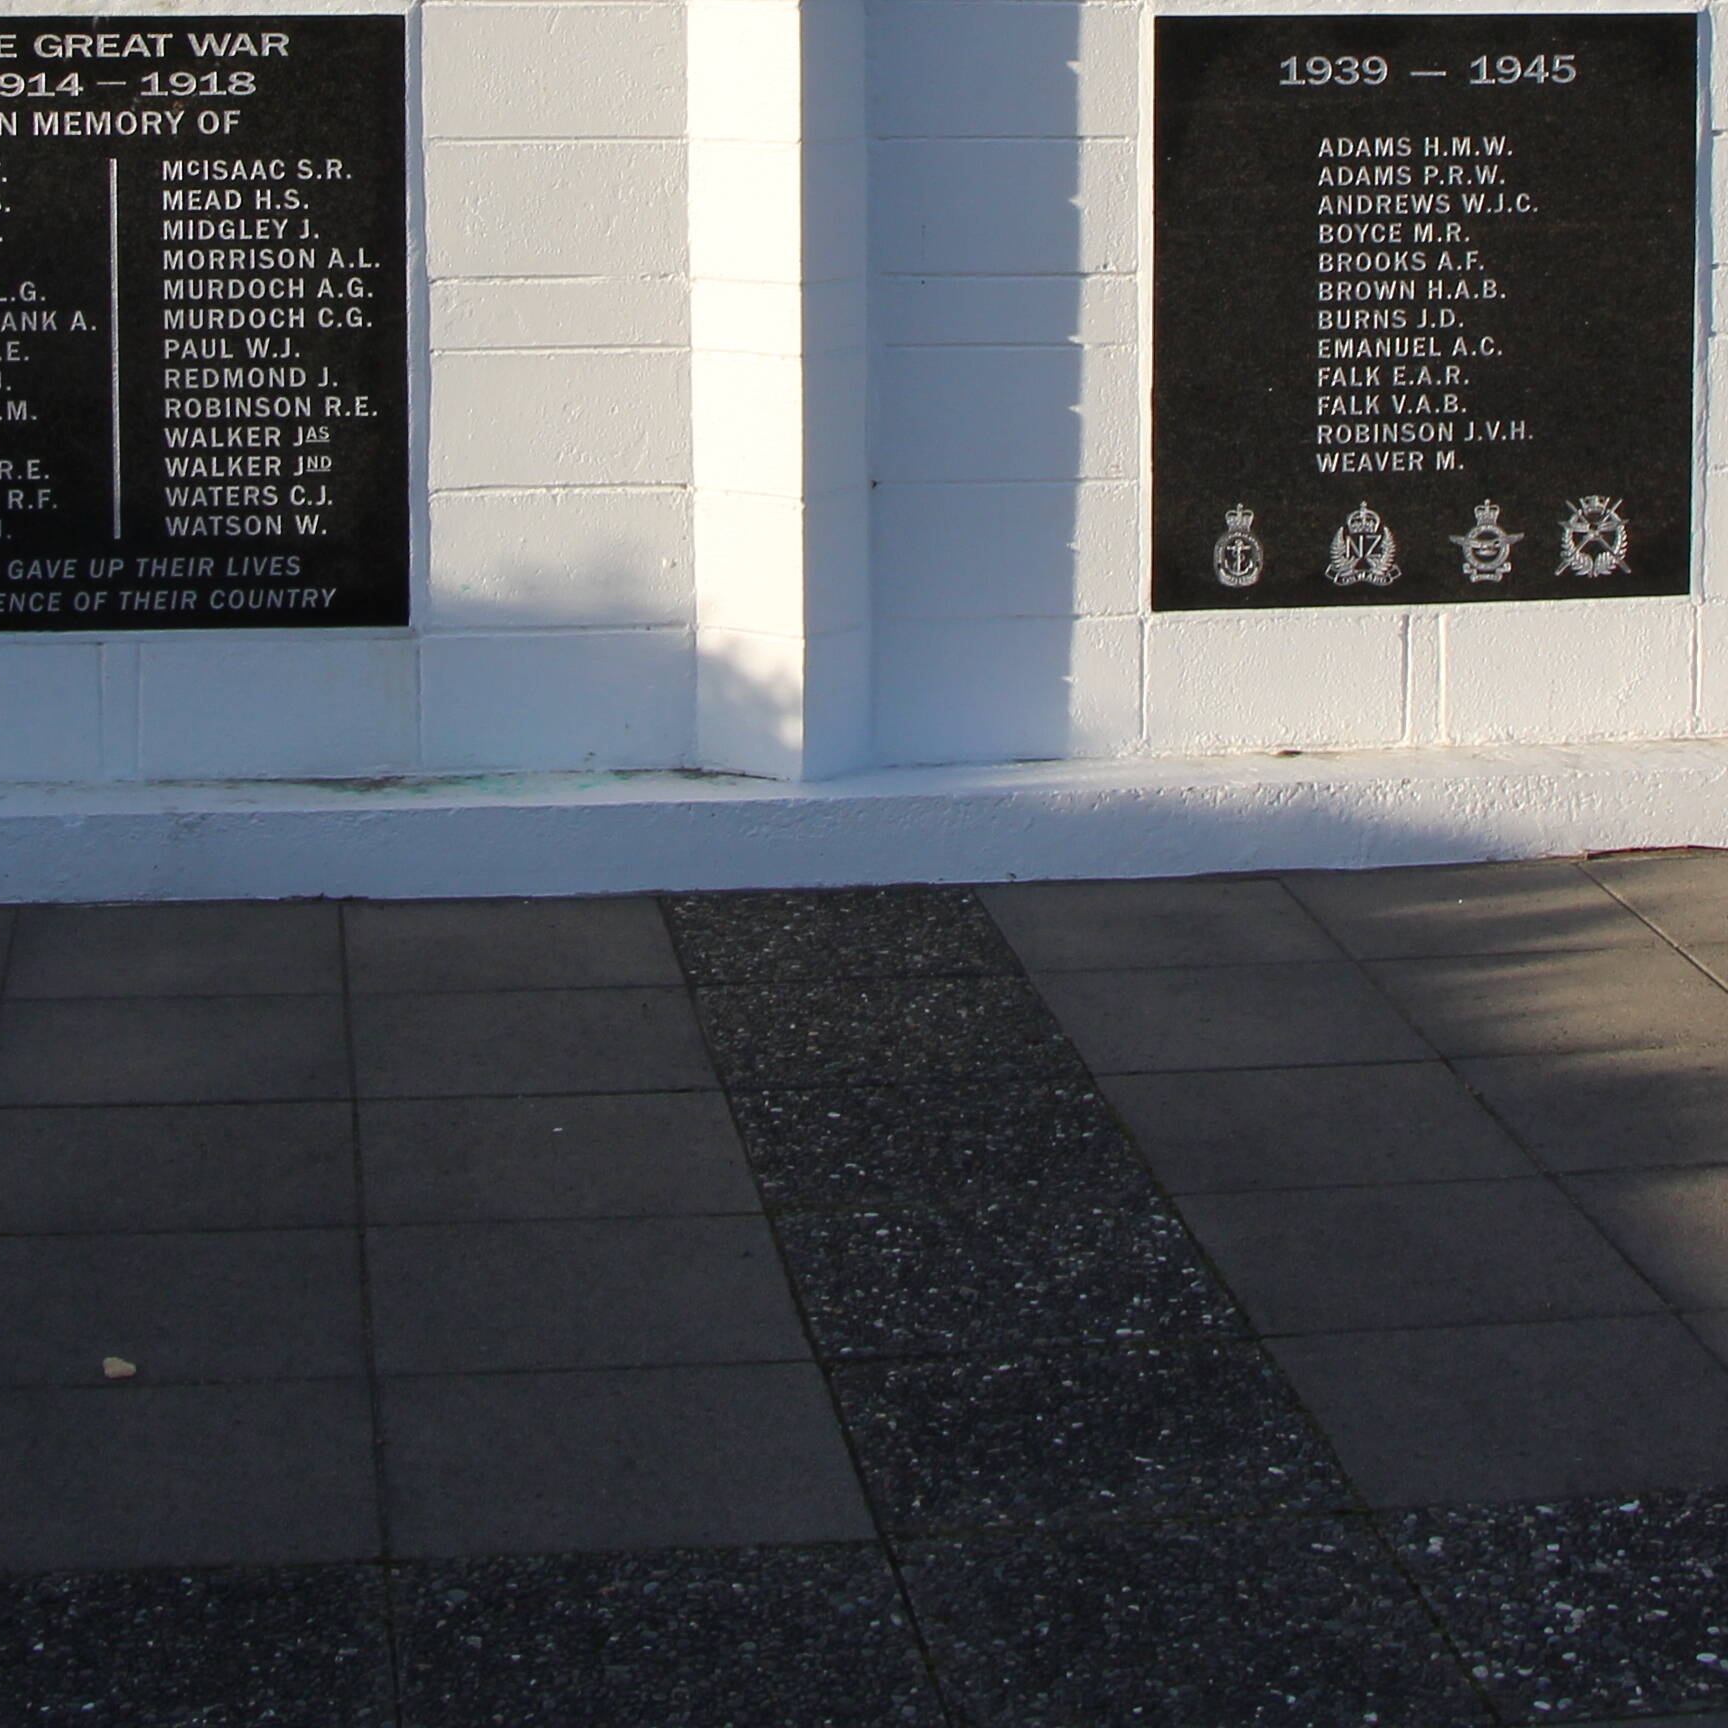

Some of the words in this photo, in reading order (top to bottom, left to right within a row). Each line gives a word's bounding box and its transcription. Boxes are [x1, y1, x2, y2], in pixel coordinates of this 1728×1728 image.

[33, 33, 174, 58] GREAT
[187, 32, 290, 57] WAR
[1279, 55, 1388, 86] 1939
[1469, 54, 1577, 85] 1945
[140, 71, 257, 97] 1918
[33, 110, 185, 136] MEMORY
[197, 110, 241, 135] OF
[1318, 137, 1412, 158] ADAMS
[1424, 135, 1513, 157] H.M.W.
[297, 158, 352, 180] S.R.
[1318, 165, 1412, 187] ADAMS
[1424, 164, 1505, 185] P.R.W.
[162, 189, 242, 211] MEAD
[255, 188, 309, 210] H.S.
[1317, 193, 1451, 215] ANDREWS
[1461, 193, 1538, 214] W.J.C.
[163, 218, 288, 241] MIDGLEY
[299, 218, 319, 240] J.
[1319, 222, 1402, 244] BOYCE
[1414, 222, 1470, 243] M.R.
[163, 248, 315, 270] MORRISON
[327, 247, 380, 269] A.L.
[1319, 250, 1427, 273] BROOKS
[1437, 250, 1484, 271] A.F.
[163, 277, 304, 300] MURDOCH
[316, 276, 373, 299] A.G.
[1319, 279, 1415, 301] BROWN
[1428, 279, 1506, 300] H.A.B.
[70, 310, 97, 331] A.
[164, 307, 305, 330] MURDOCH
[318, 306, 372, 328] C.G.
[1318, 309, 1407, 330] BURNS
[1417, 308, 1464, 329] J.D.
[164, 338, 234, 360] PAUL
[245, 337, 300, 359] W.J.
[1318, 336, 1442, 359] EMANUEL
[1451, 335, 1503, 357] A.C.
[164, 367, 306, 389] REDMOND
[317, 366, 338, 388] J.
[1317, 366, 1380, 388] FALK
[1393, 365, 1469, 386] E.A.R.
[164, 396, 311, 419] ROBINSON
[325, 395, 378, 417] R.E.
[1317, 394, 1380, 416] FALK
[1391, 393, 1467, 415] V.A.B.
[164, 426, 281, 449] WALKER
[1317, 421, 1453, 445] ROBINSON
[1464, 420, 1533, 442] J.V.H.
[164, 455, 282, 478] WALKER
[1316, 451, 1424, 473] WEAVER
[1436, 450, 1464, 471] M.
[7, 488, 57, 510] R.F.
[165, 485, 279, 507] WATERS
[290, 484, 333, 506] C.J.
[165, 514, 282, 537] WATSON
[295, 514, 327, 535] W.
[1345, 534, 1383, 559] NZ
[7, 558, 78, 580] GAVE
[89, 558, 124, 579] UP
[136, 556, 215, 578] THEIR
[226, 555, 301, 577] LIVES
[73, 591, 108, 612] OF
[119, 590, 198, 611] THEIR
[209, 587, 337, 610] COUNTRY
